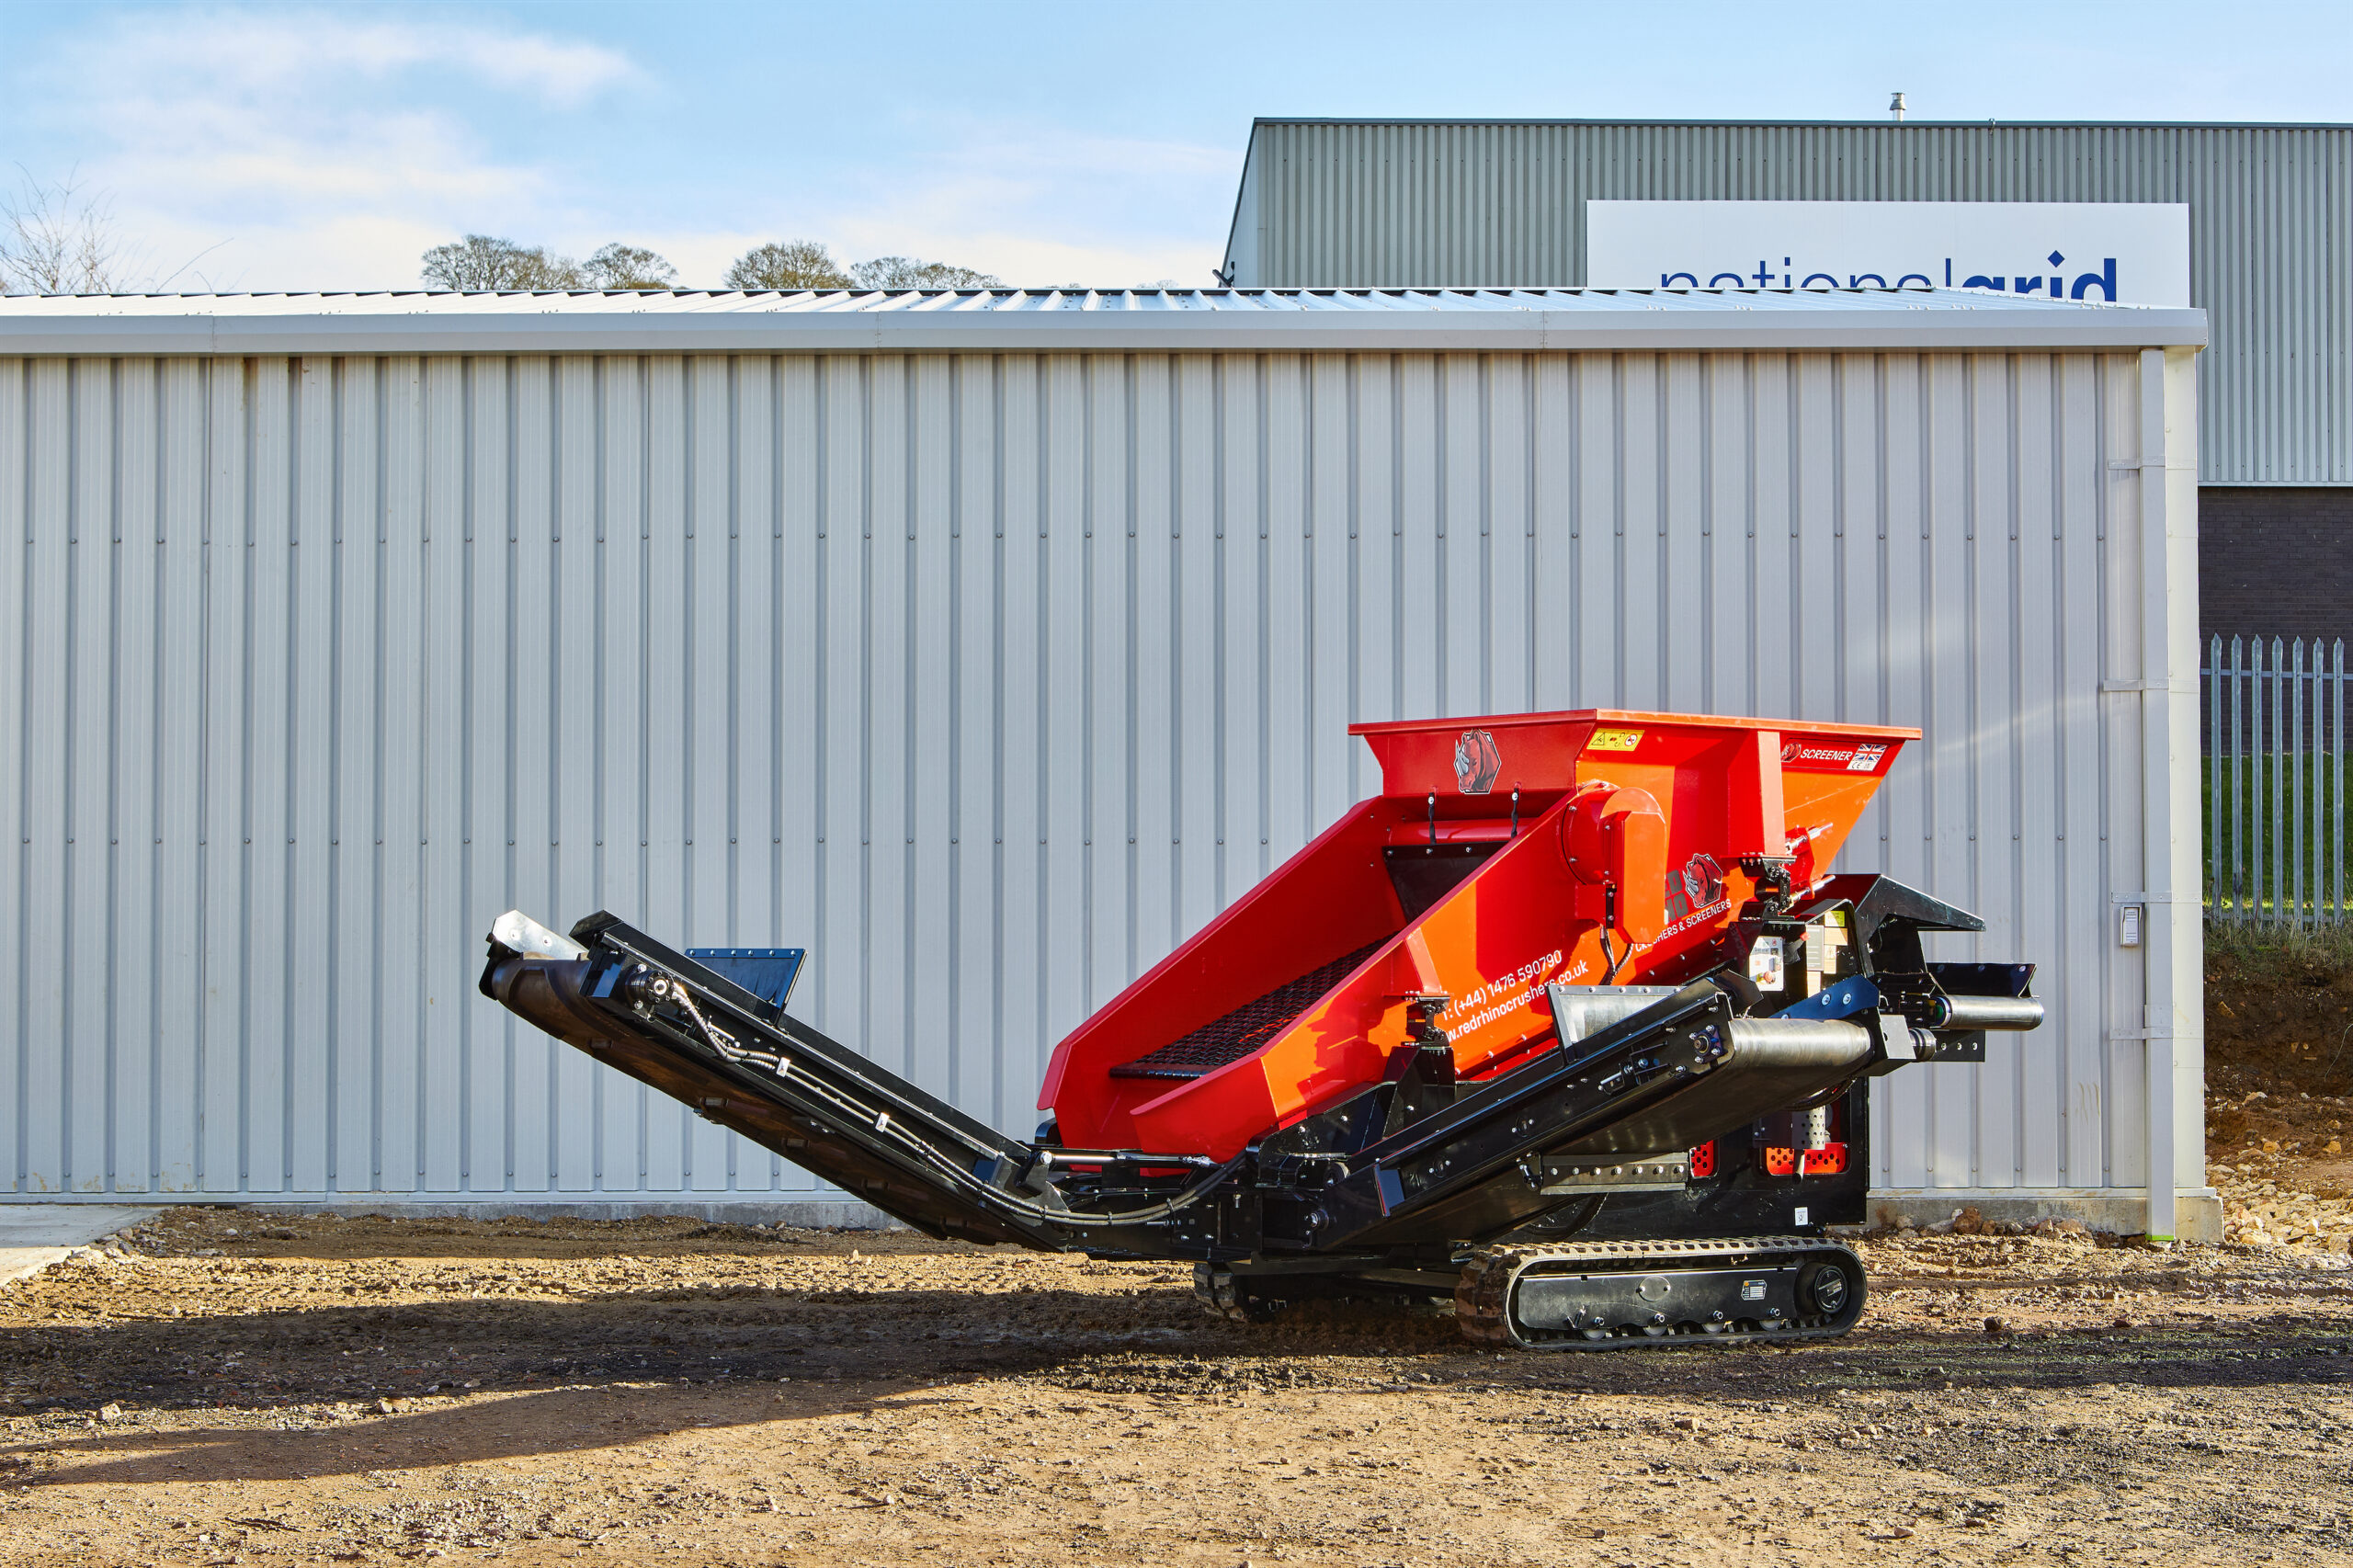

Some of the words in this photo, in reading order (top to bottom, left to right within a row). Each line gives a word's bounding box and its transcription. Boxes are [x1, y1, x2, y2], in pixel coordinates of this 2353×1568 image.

[1800, 748, 1853, 761] SCREENER
[1635, 925, 1679, 952] CRHERS
[1678, 921, 1686, 931] &
[1686, 898, 1732, 928] SCREENERS
[1454, 987, 1487, 1017] (+44)
[1487, 972, 1516, 997] 1476
[1517, 949, 1563, 983] 590790
